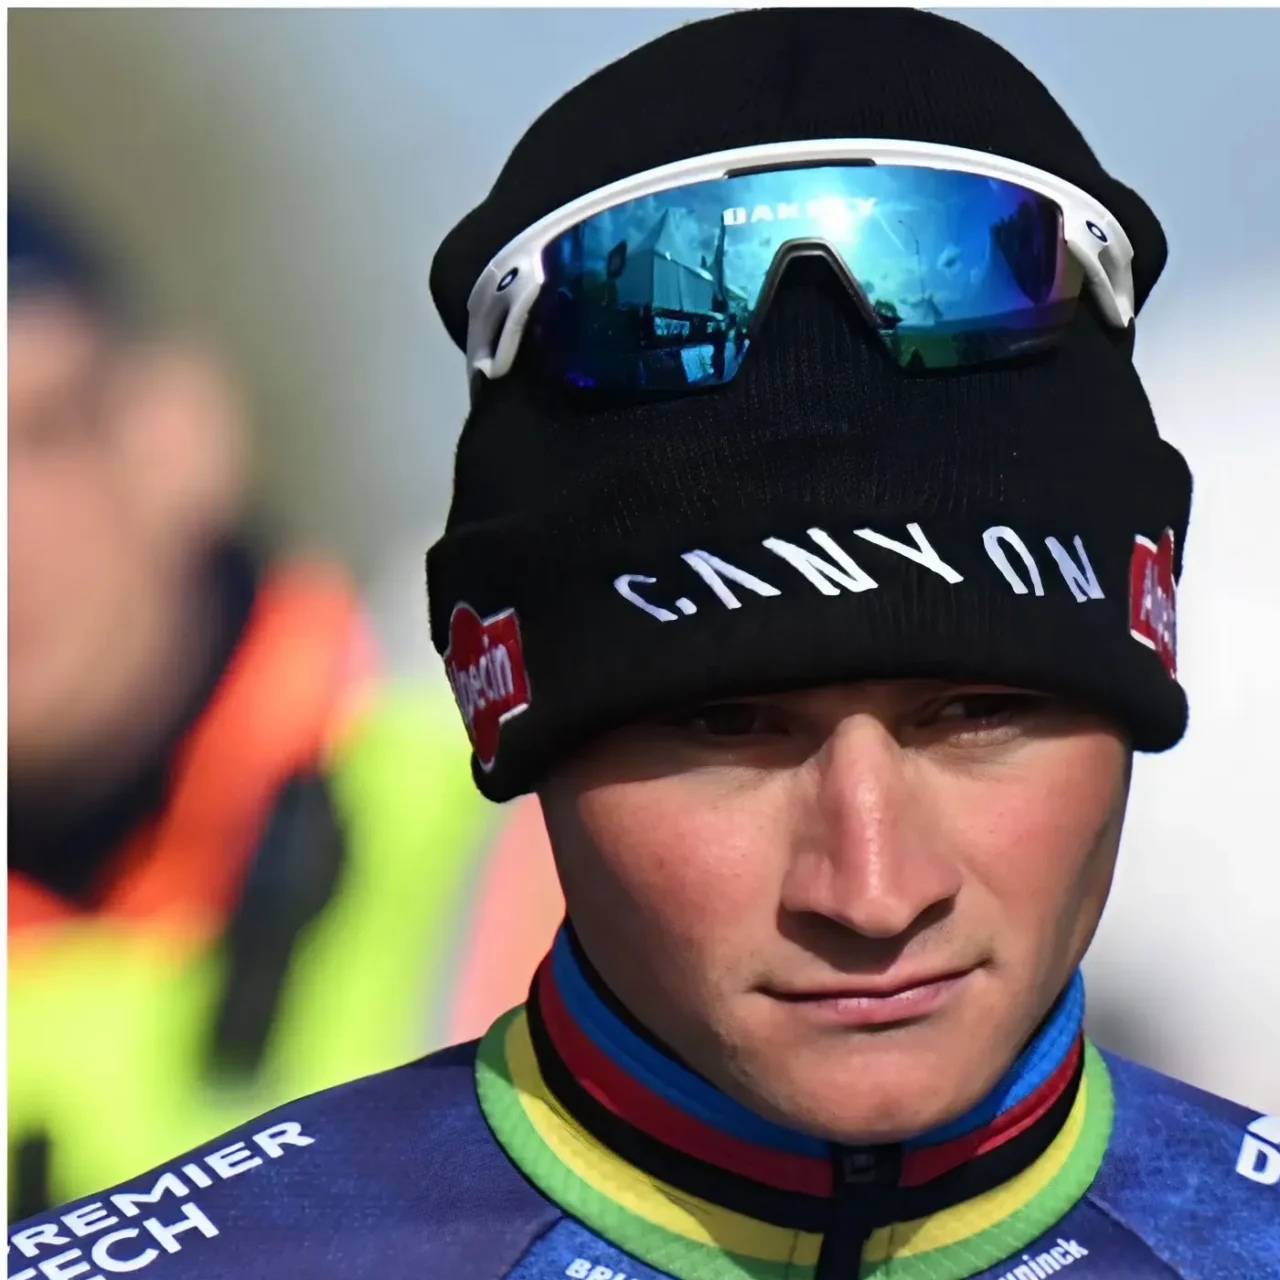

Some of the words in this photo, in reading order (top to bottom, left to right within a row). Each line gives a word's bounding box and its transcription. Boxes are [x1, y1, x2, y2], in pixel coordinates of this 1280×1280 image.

[722, 197, 877, 226] OAKY
[613, 522, 1106, 623] CANYON
[8, 1120, 315, 1258] REMIER
